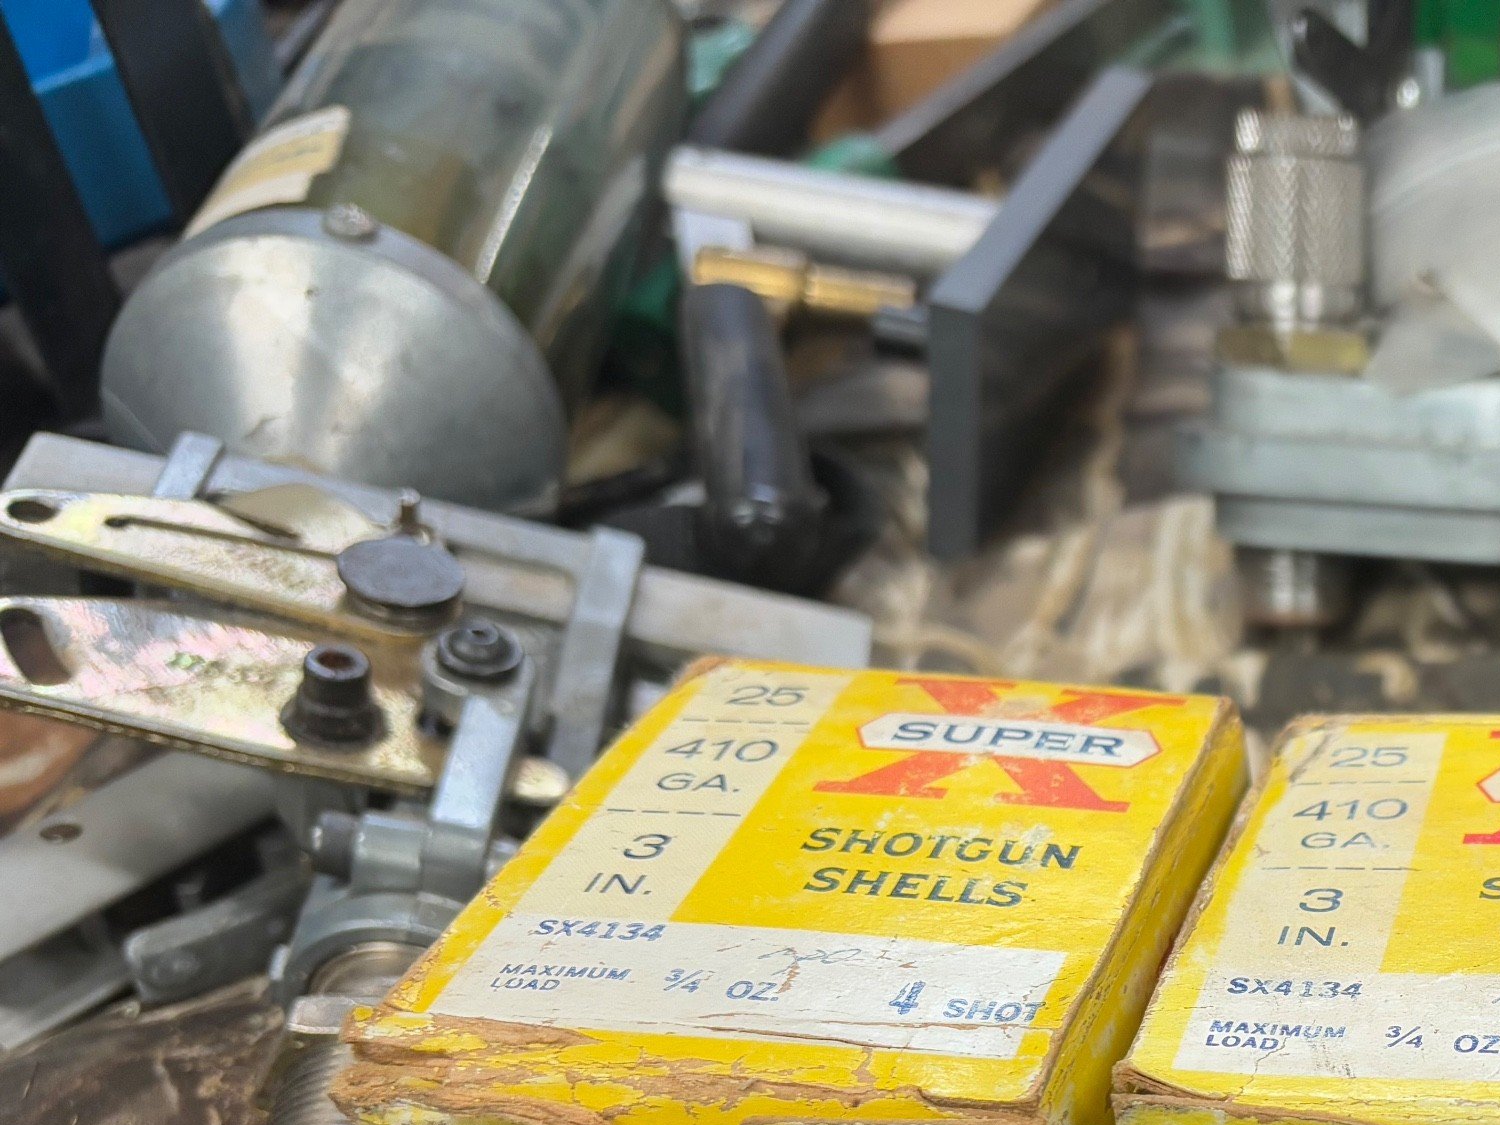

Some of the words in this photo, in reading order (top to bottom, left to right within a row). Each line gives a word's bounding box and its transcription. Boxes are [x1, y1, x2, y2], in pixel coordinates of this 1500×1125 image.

[725, 685, 810, 706] 25
[665, 738, 779, 762] 410
[891, 721, 1126, 758] SUPER
[1329, 746, 1410, 768] 25
[657, 772, 740, 792] GA.
[1293, 798, 1409, 821] 410
[623, 833, 673, 860] 3
[800, 826, 1083, 870] SHOTGUN
[1301, 832, 1390, 849] GA.
[584, 872, 652, 895] IN.
[803, 866, 1028, 908] SHELLS
[1298, 888, 1344, 913] 3
[535, 919, 667, 942] SX4134
[1277, 926, 1349, 947] IN.
[490, 976, 561, 992] LOAD
[499, 963, 632, 982] MAXIMUM
[726, 980, 780, 1001] OZ.
[888, 980, 926, 1015] 4
[942, 997, 1046, 1023] SHOT
[1227, 977, 1363, 999] SX4134
[1209, 1019, 1347, 1039] MAXIMUM
[1206, 1035, 1279, 1051] LOAD
